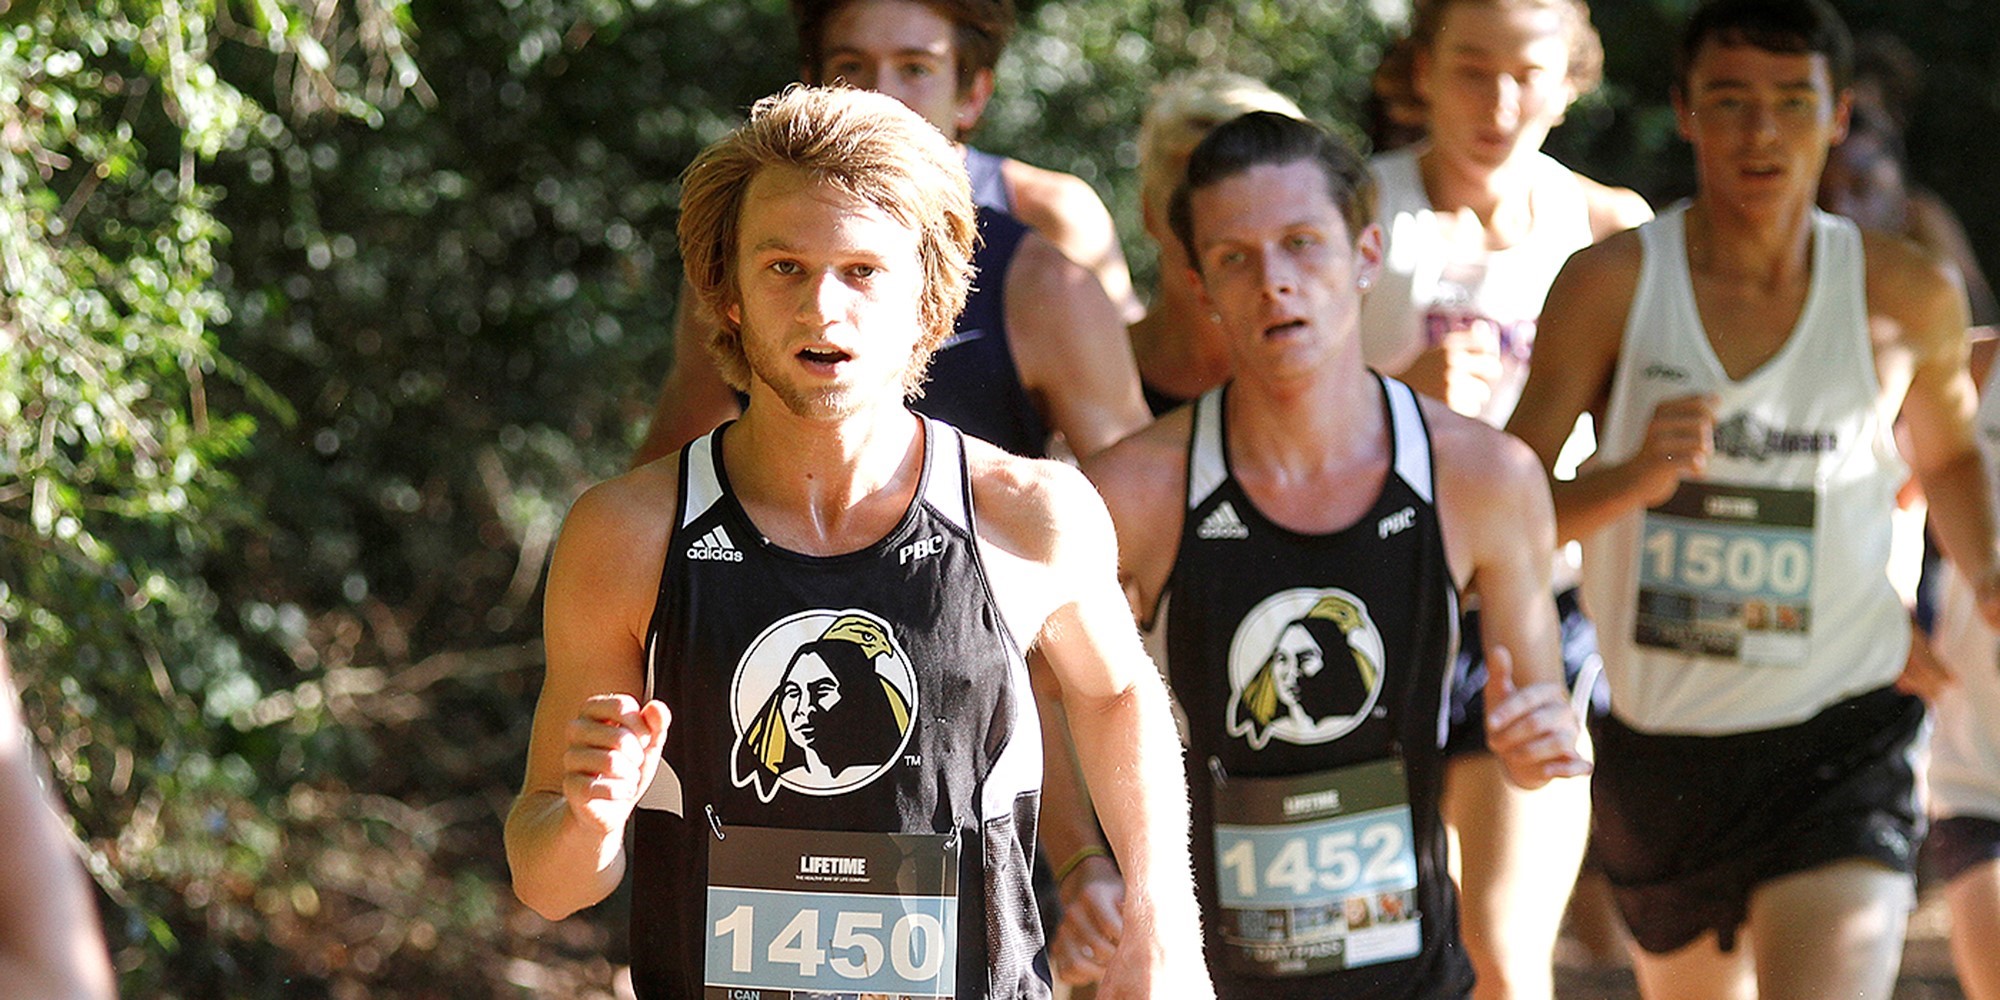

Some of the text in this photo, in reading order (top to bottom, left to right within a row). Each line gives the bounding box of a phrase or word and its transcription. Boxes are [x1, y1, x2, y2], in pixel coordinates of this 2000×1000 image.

[686, 547, 744, 562] adidas
[899, 535, 943, 565] PBC
[1646, 528, 1810, 595] 1500
[904, 755, 921, 767] TM
[800, 856, 866, 875] LIFETIME
[1222, 822, 1408, 897] 1452
[714, 905, 945, 982] 1450
[728, 989, 760, 1000] I CAN
